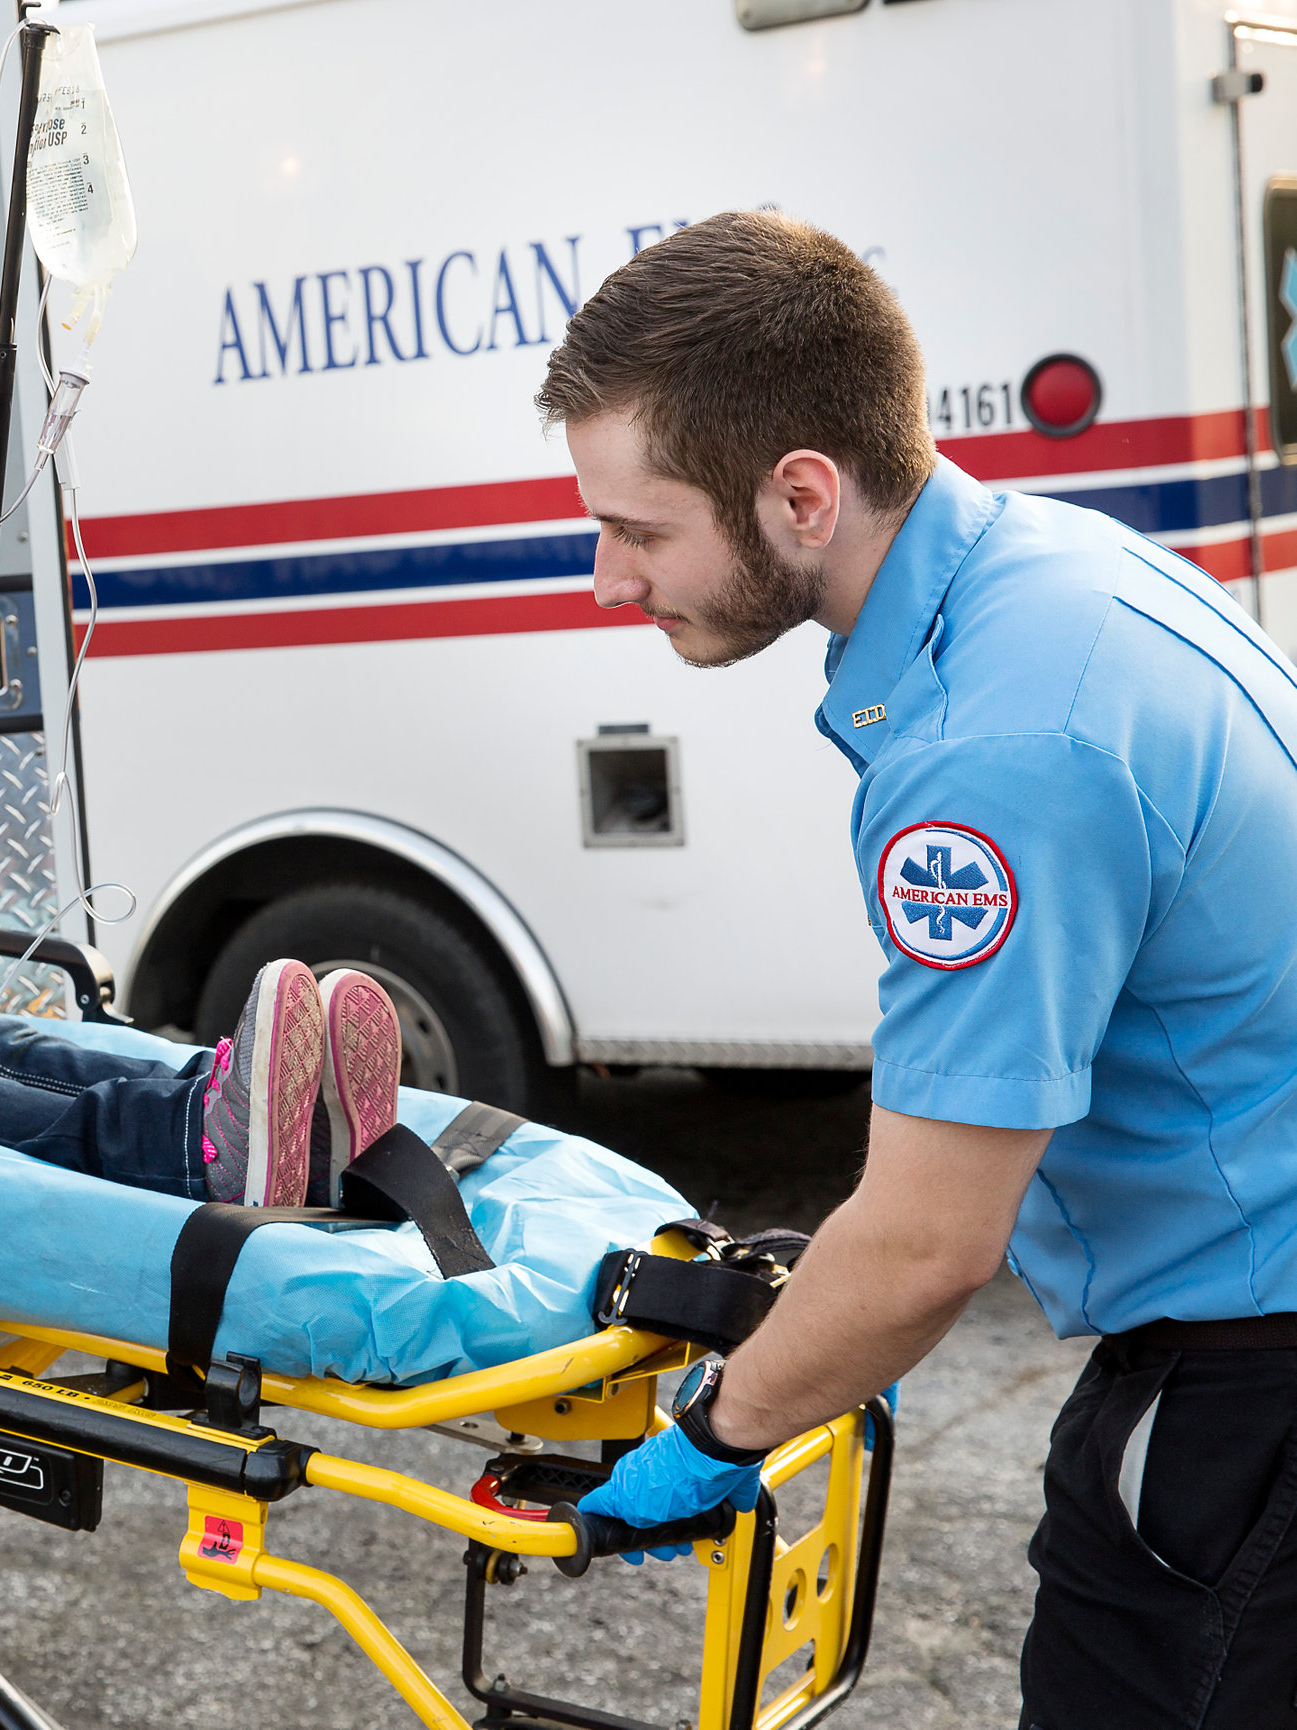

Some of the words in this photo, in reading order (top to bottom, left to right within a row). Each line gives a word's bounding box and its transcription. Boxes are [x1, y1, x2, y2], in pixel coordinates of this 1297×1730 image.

[47, 131, 68, 147] USP
[82, 154, 90, 165] 3
[87, 184, 94, 194] 4
[213, 234, 582, 384] AMERICAN
[926, 384, 1012, 430] 4161
[892, 886, 969, 906] AMERICAN
[972, 893, 1008, 907] EMS
[22, 1379, 54, 1392] 650
[56, 1388, 80, 1398] LB
